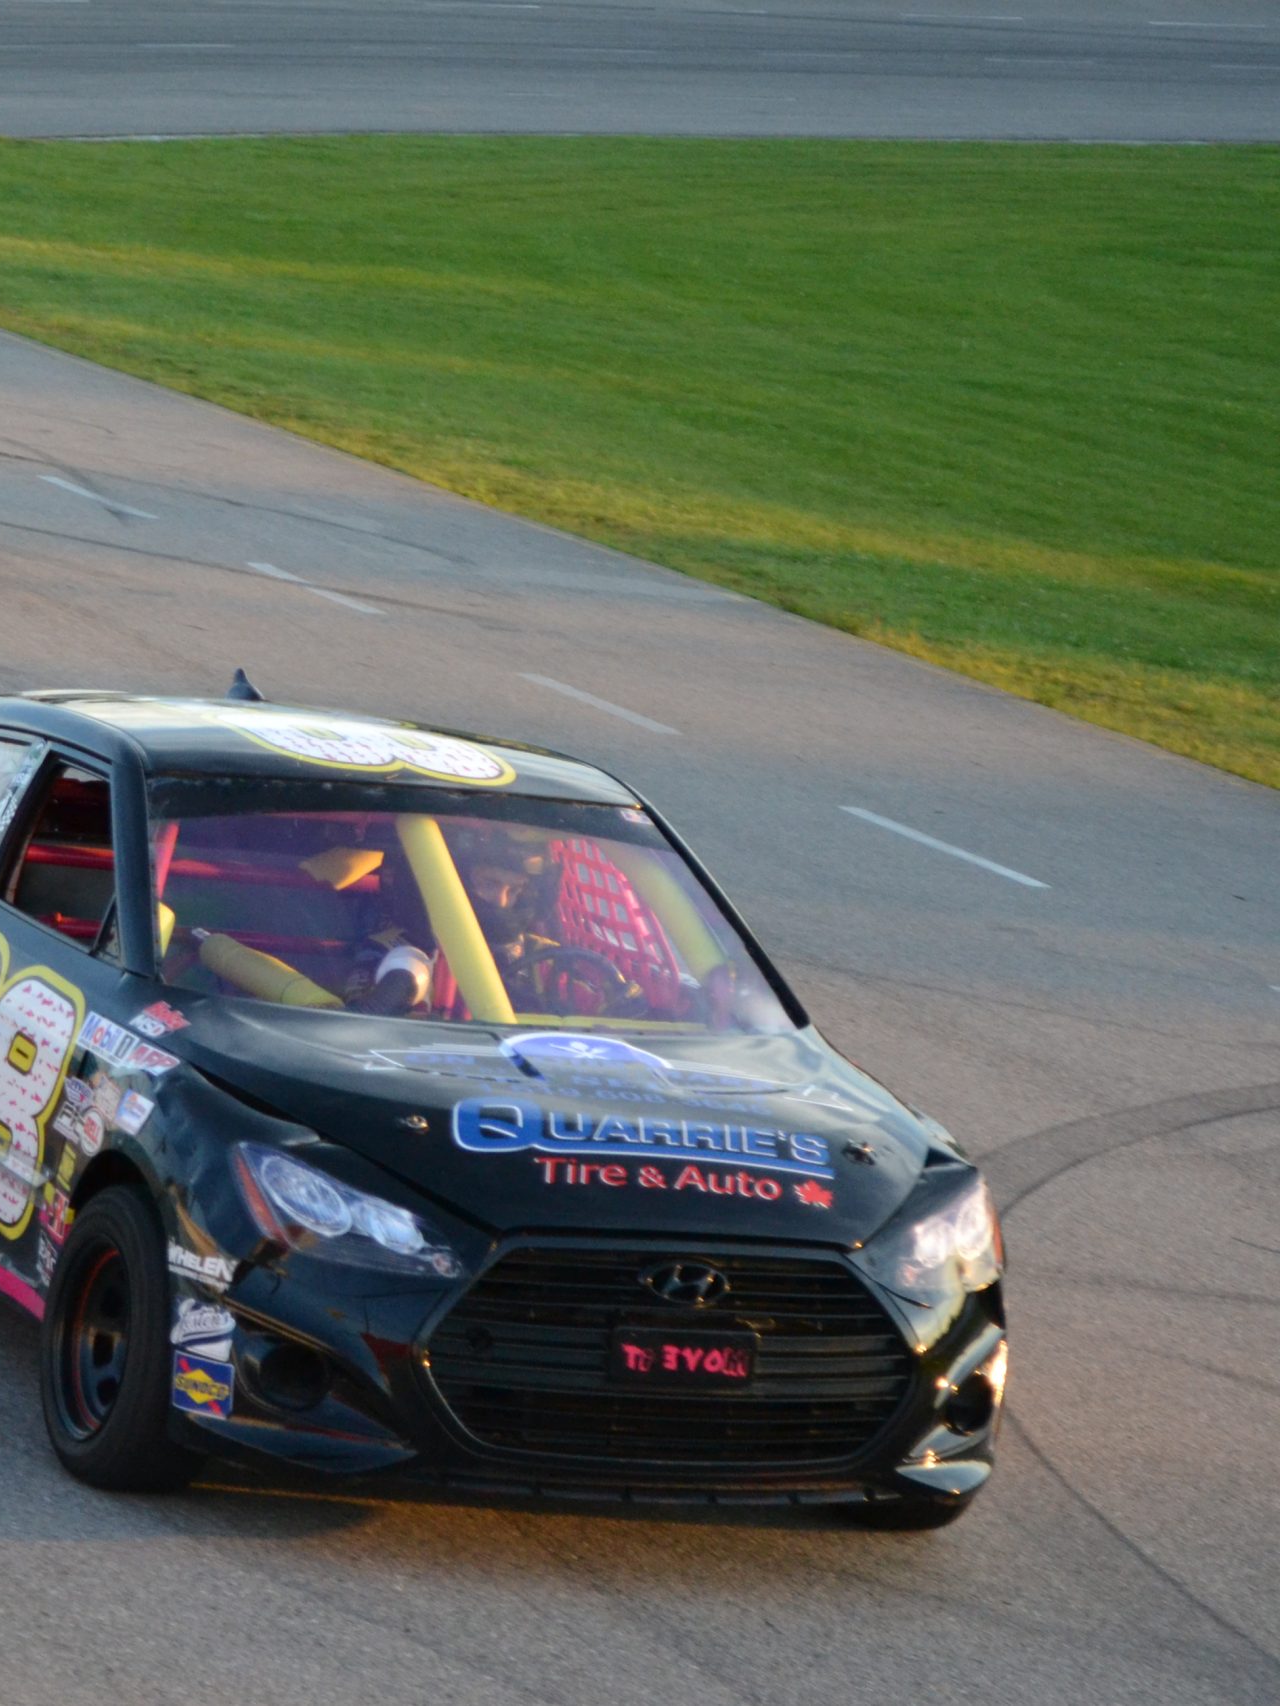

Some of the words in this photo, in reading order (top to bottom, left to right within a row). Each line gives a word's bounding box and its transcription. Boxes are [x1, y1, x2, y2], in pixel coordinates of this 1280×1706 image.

[80, 1013, 123, 1053] Mobil
[451, 1096, 835, 1179] QUARRIE'S
[533, 1155, 628, 1188] Tire
[638, 1164, 667, 1190] &
[673, 1165, 783, 1200] Auto
[175, 1371, 231, 1401] SUNOCO
